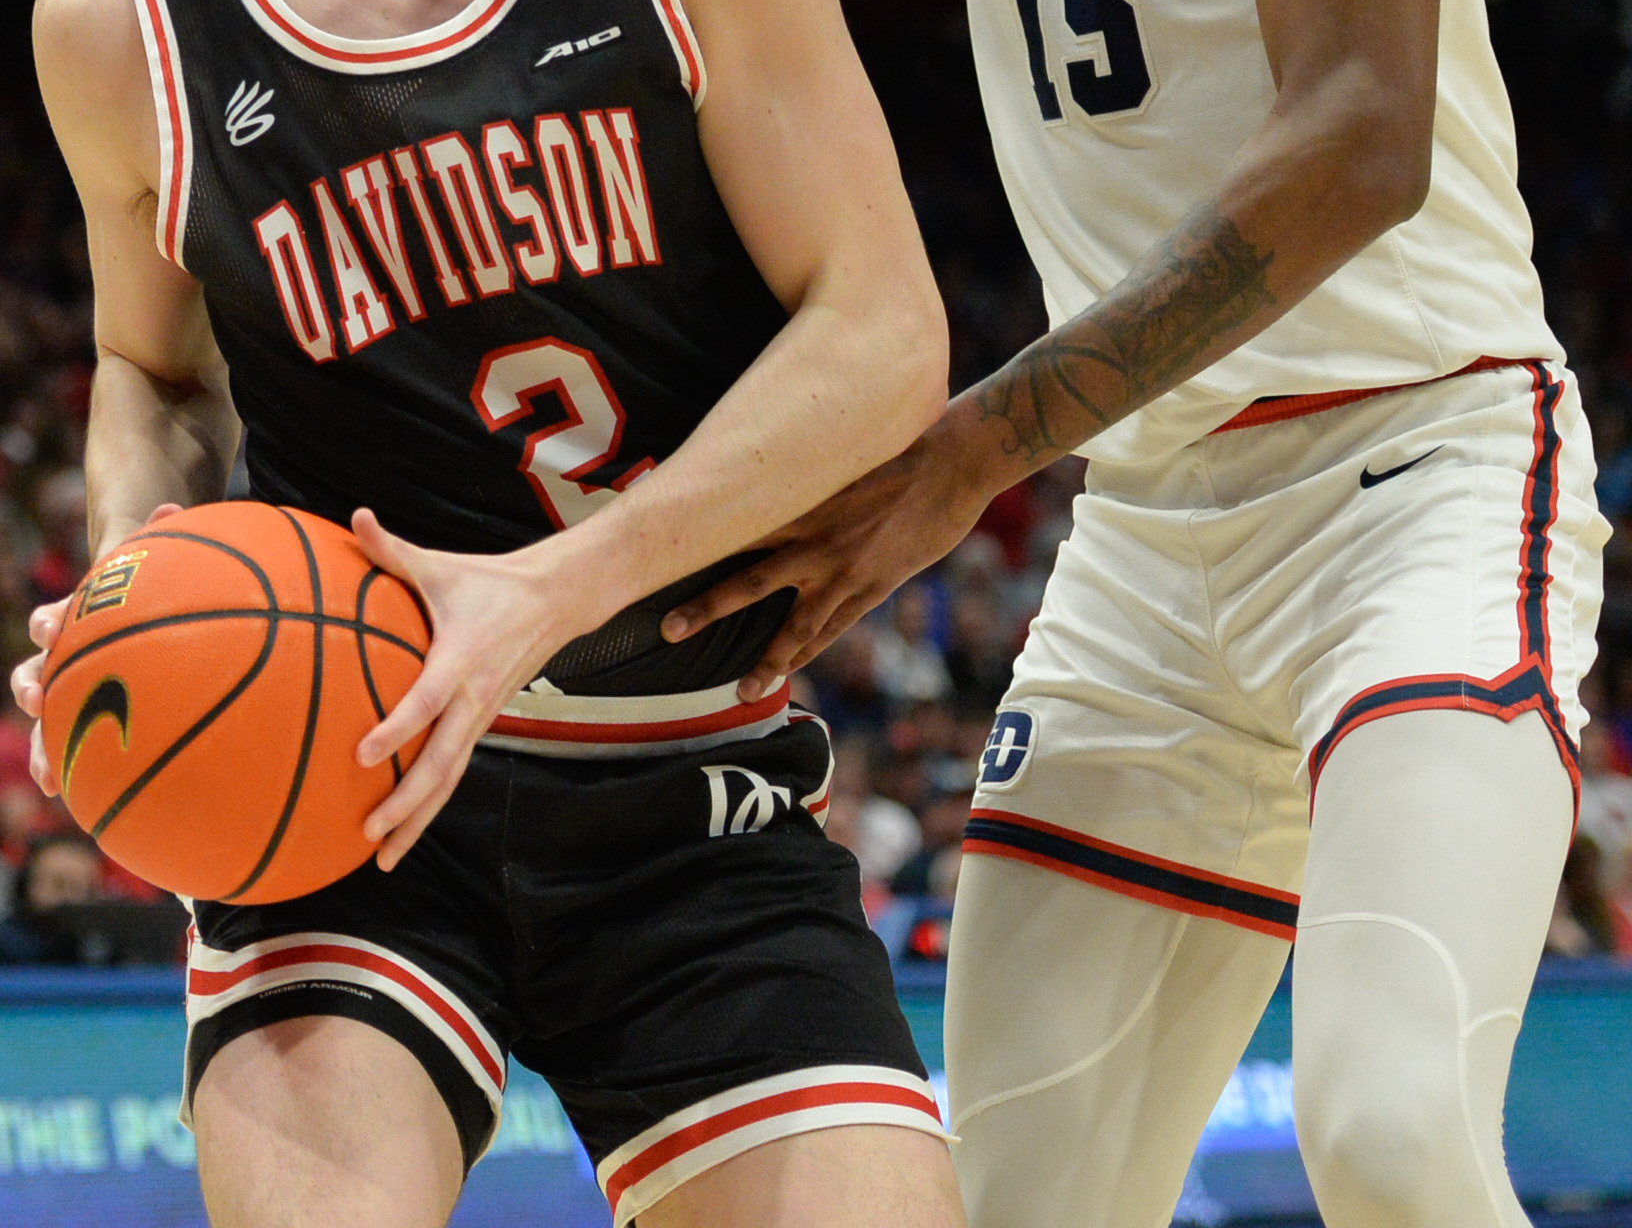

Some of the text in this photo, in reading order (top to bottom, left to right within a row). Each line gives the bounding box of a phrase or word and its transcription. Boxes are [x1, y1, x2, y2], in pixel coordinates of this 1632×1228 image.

[535, 25, 622, 67] A10
[252, 107, 663, 363] DAVIDSON
[470, 336, 656, 534] 2
